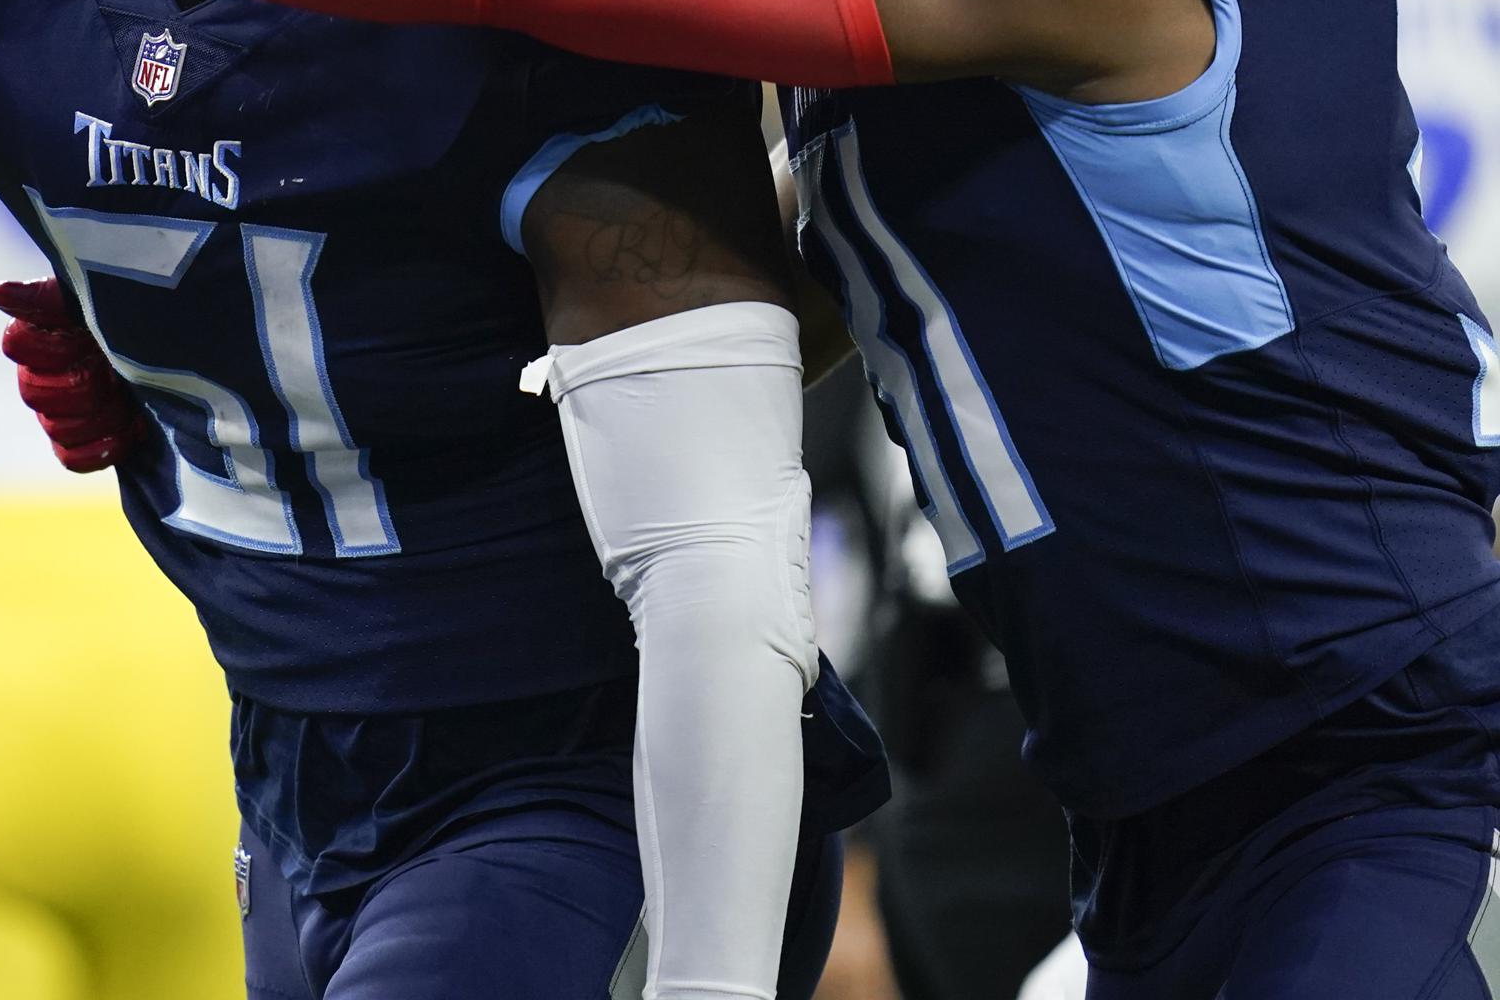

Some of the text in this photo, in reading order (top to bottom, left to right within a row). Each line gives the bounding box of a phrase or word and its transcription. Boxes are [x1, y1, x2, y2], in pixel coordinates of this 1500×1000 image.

[139, 60, 170, 93] NFL
[73, 110, 242, 211] TITANS
[22, 184, 402, 560] 51
